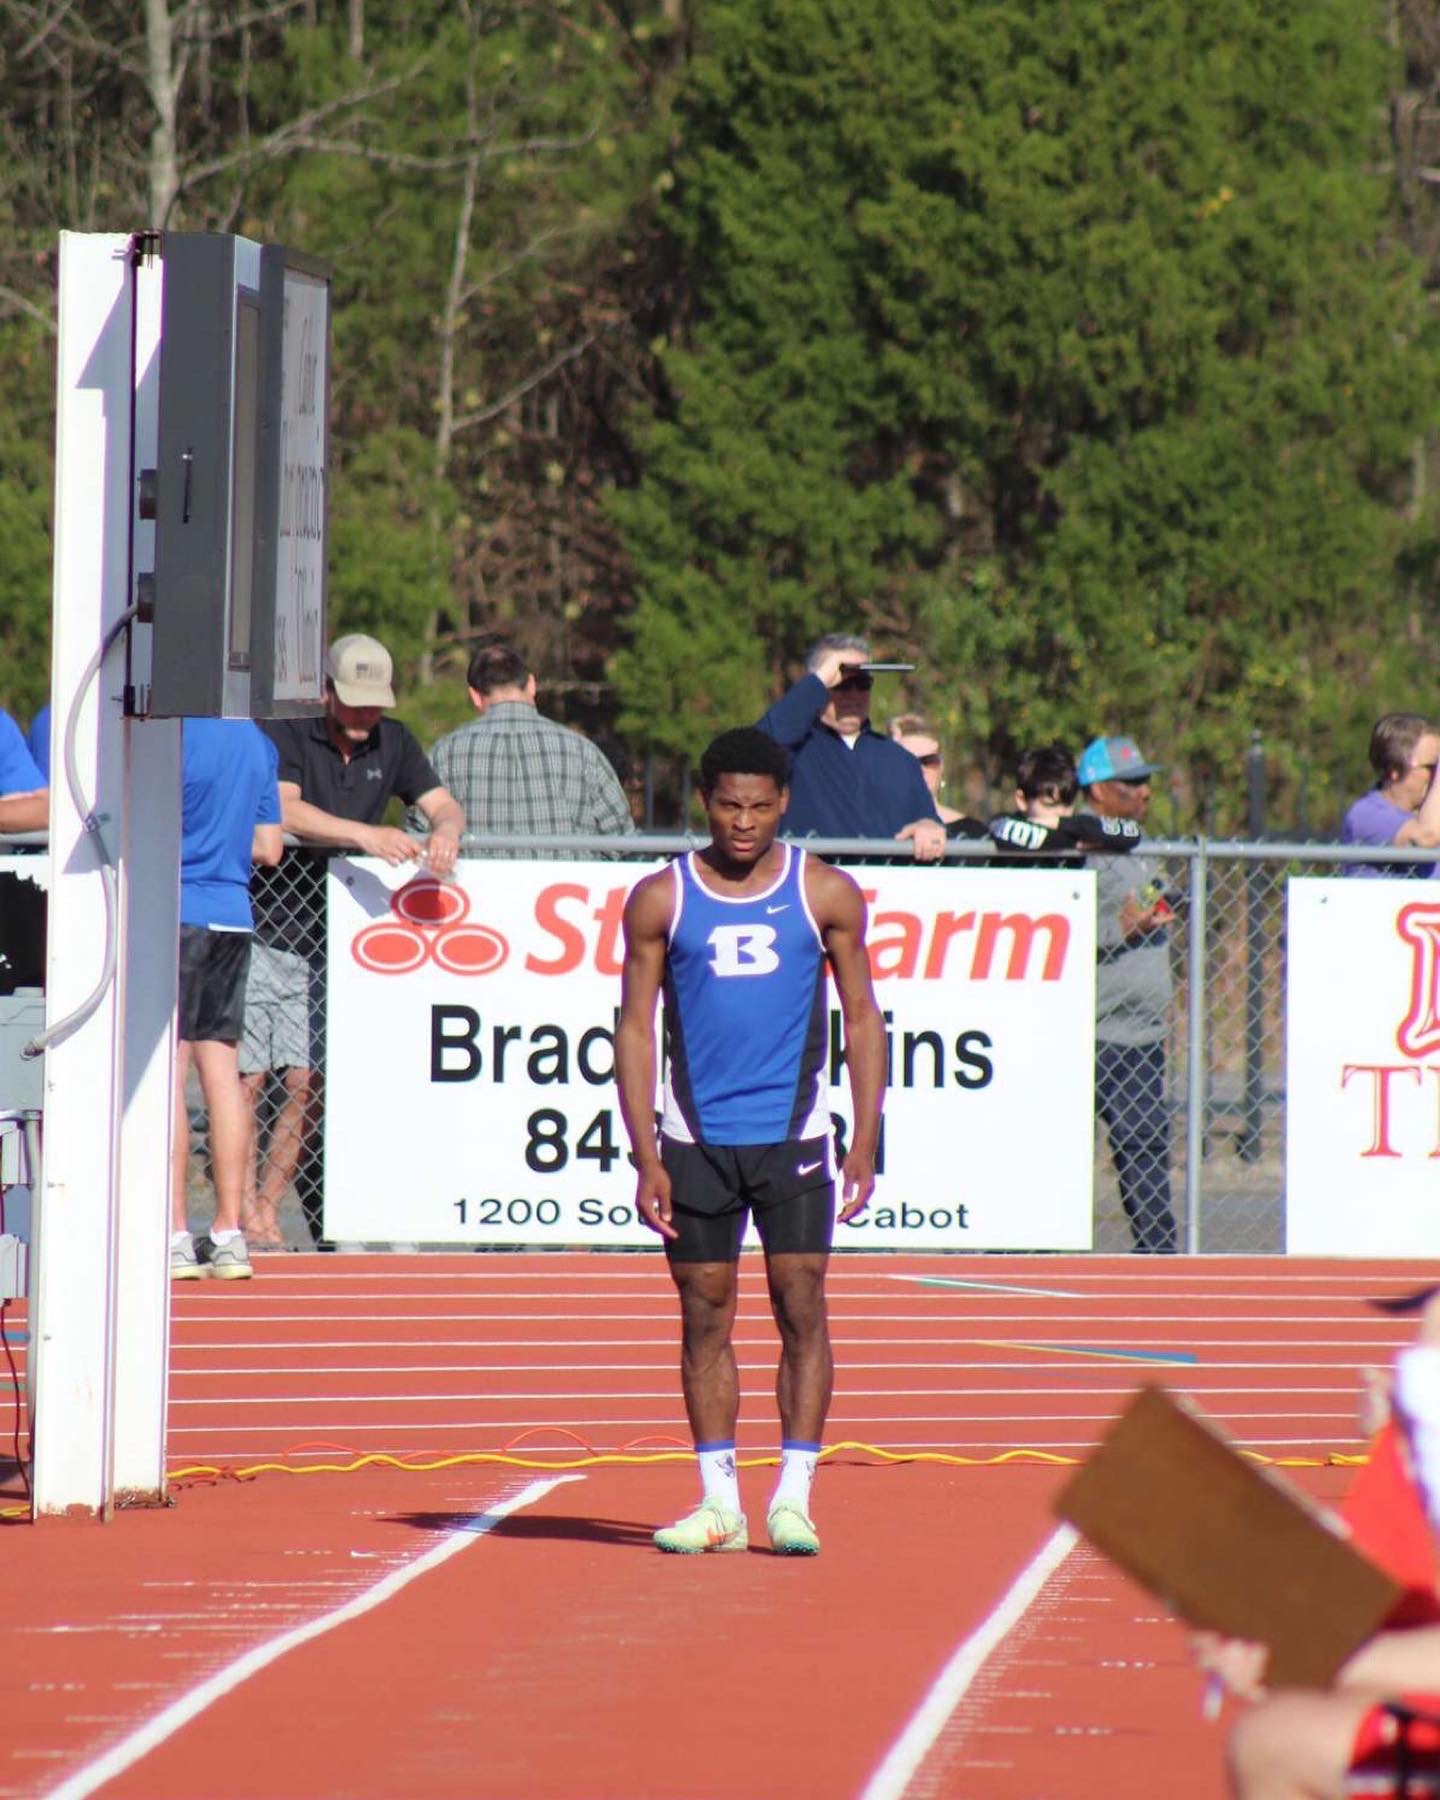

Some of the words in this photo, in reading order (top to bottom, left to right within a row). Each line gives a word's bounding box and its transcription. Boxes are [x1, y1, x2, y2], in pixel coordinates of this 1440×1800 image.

[707, 923, 780, 977] B
[430, 1004, 620, 1085] Brad
[453, 1198, 561, 1226] 1200
